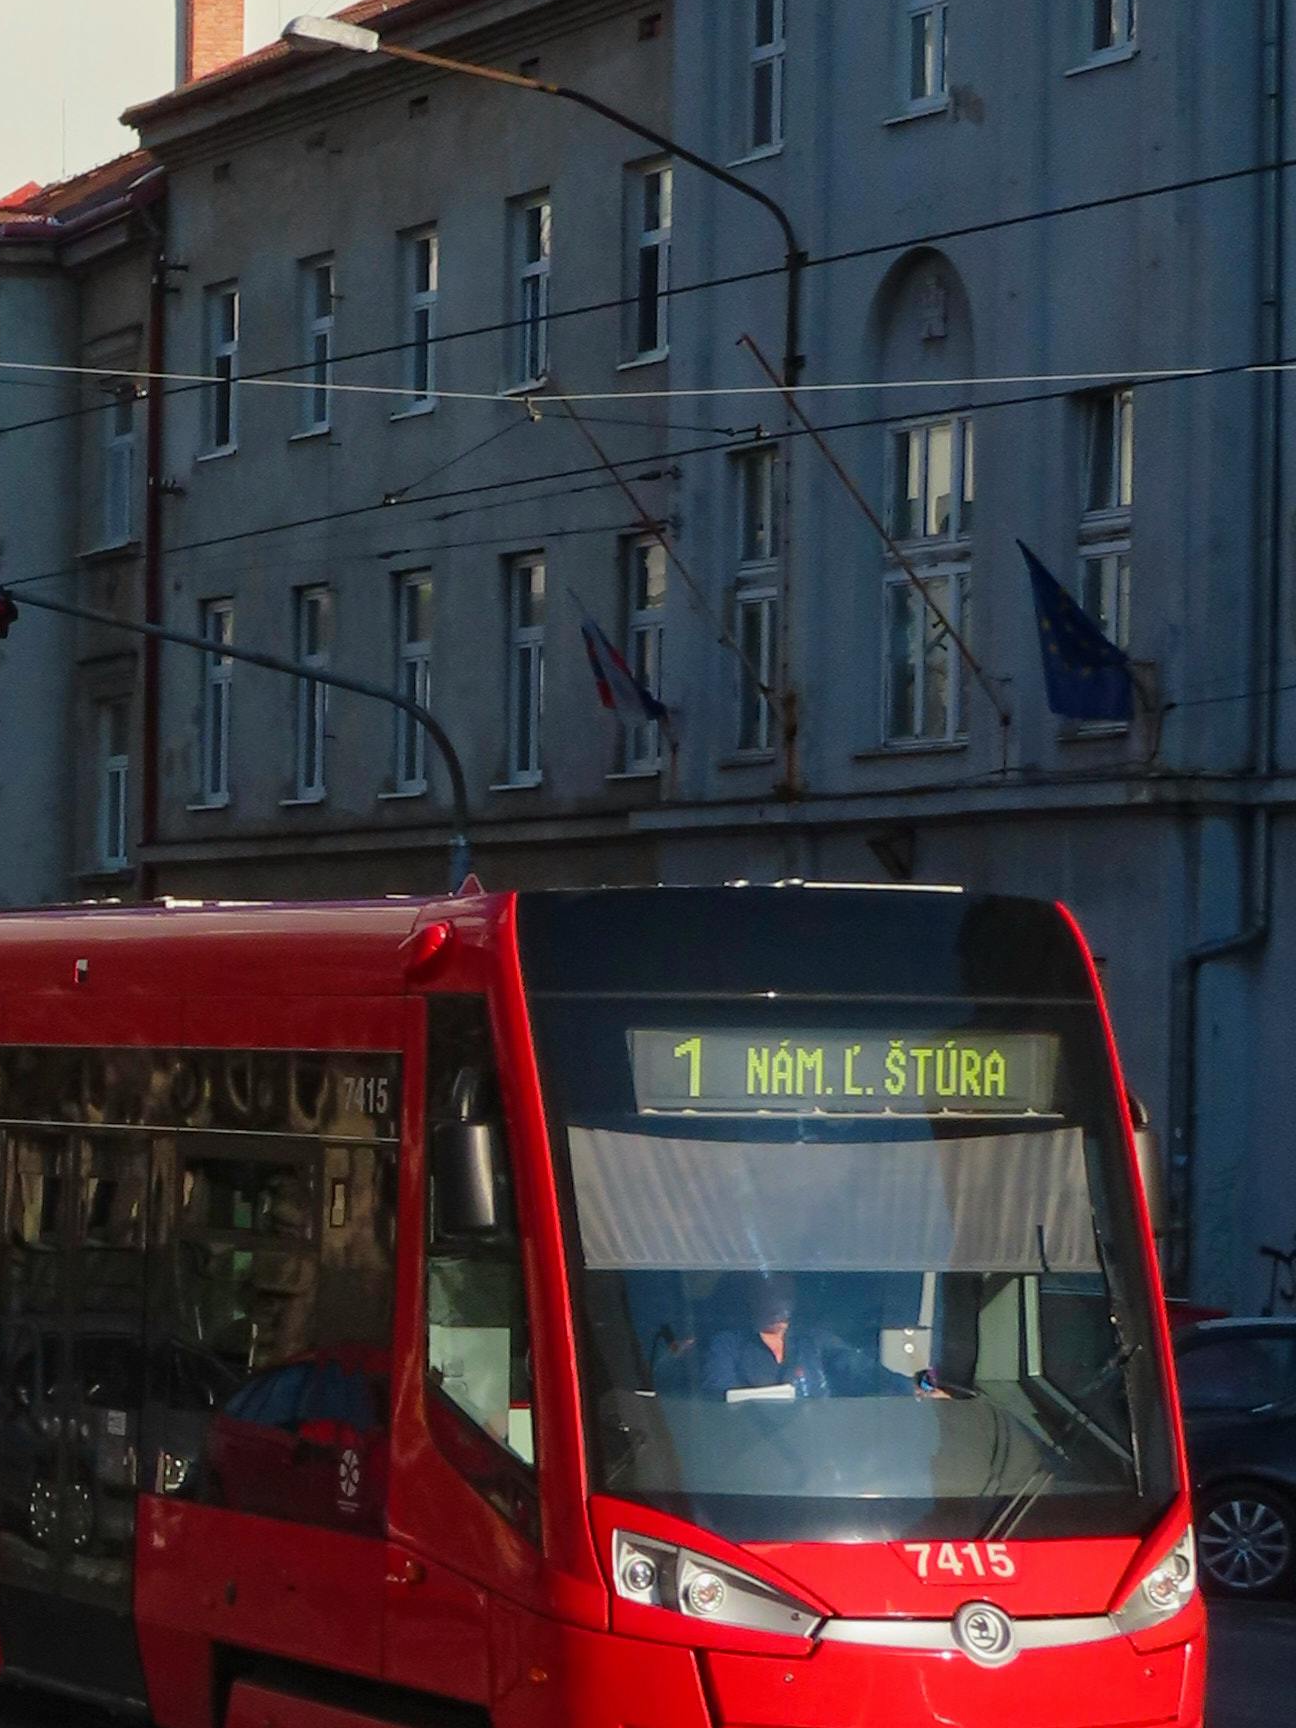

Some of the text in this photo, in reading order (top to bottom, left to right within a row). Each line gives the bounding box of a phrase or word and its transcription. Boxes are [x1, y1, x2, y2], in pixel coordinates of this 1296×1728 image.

[673, 1036, 702, 1098] 1
[746, 1039, 833, 1096] NÁM.
[885, 1039, 1007, 1097] ŠTÚRA
[344, 1076, 389, 1114] 7415
[903, 1541, 1017, 1578] 7415
